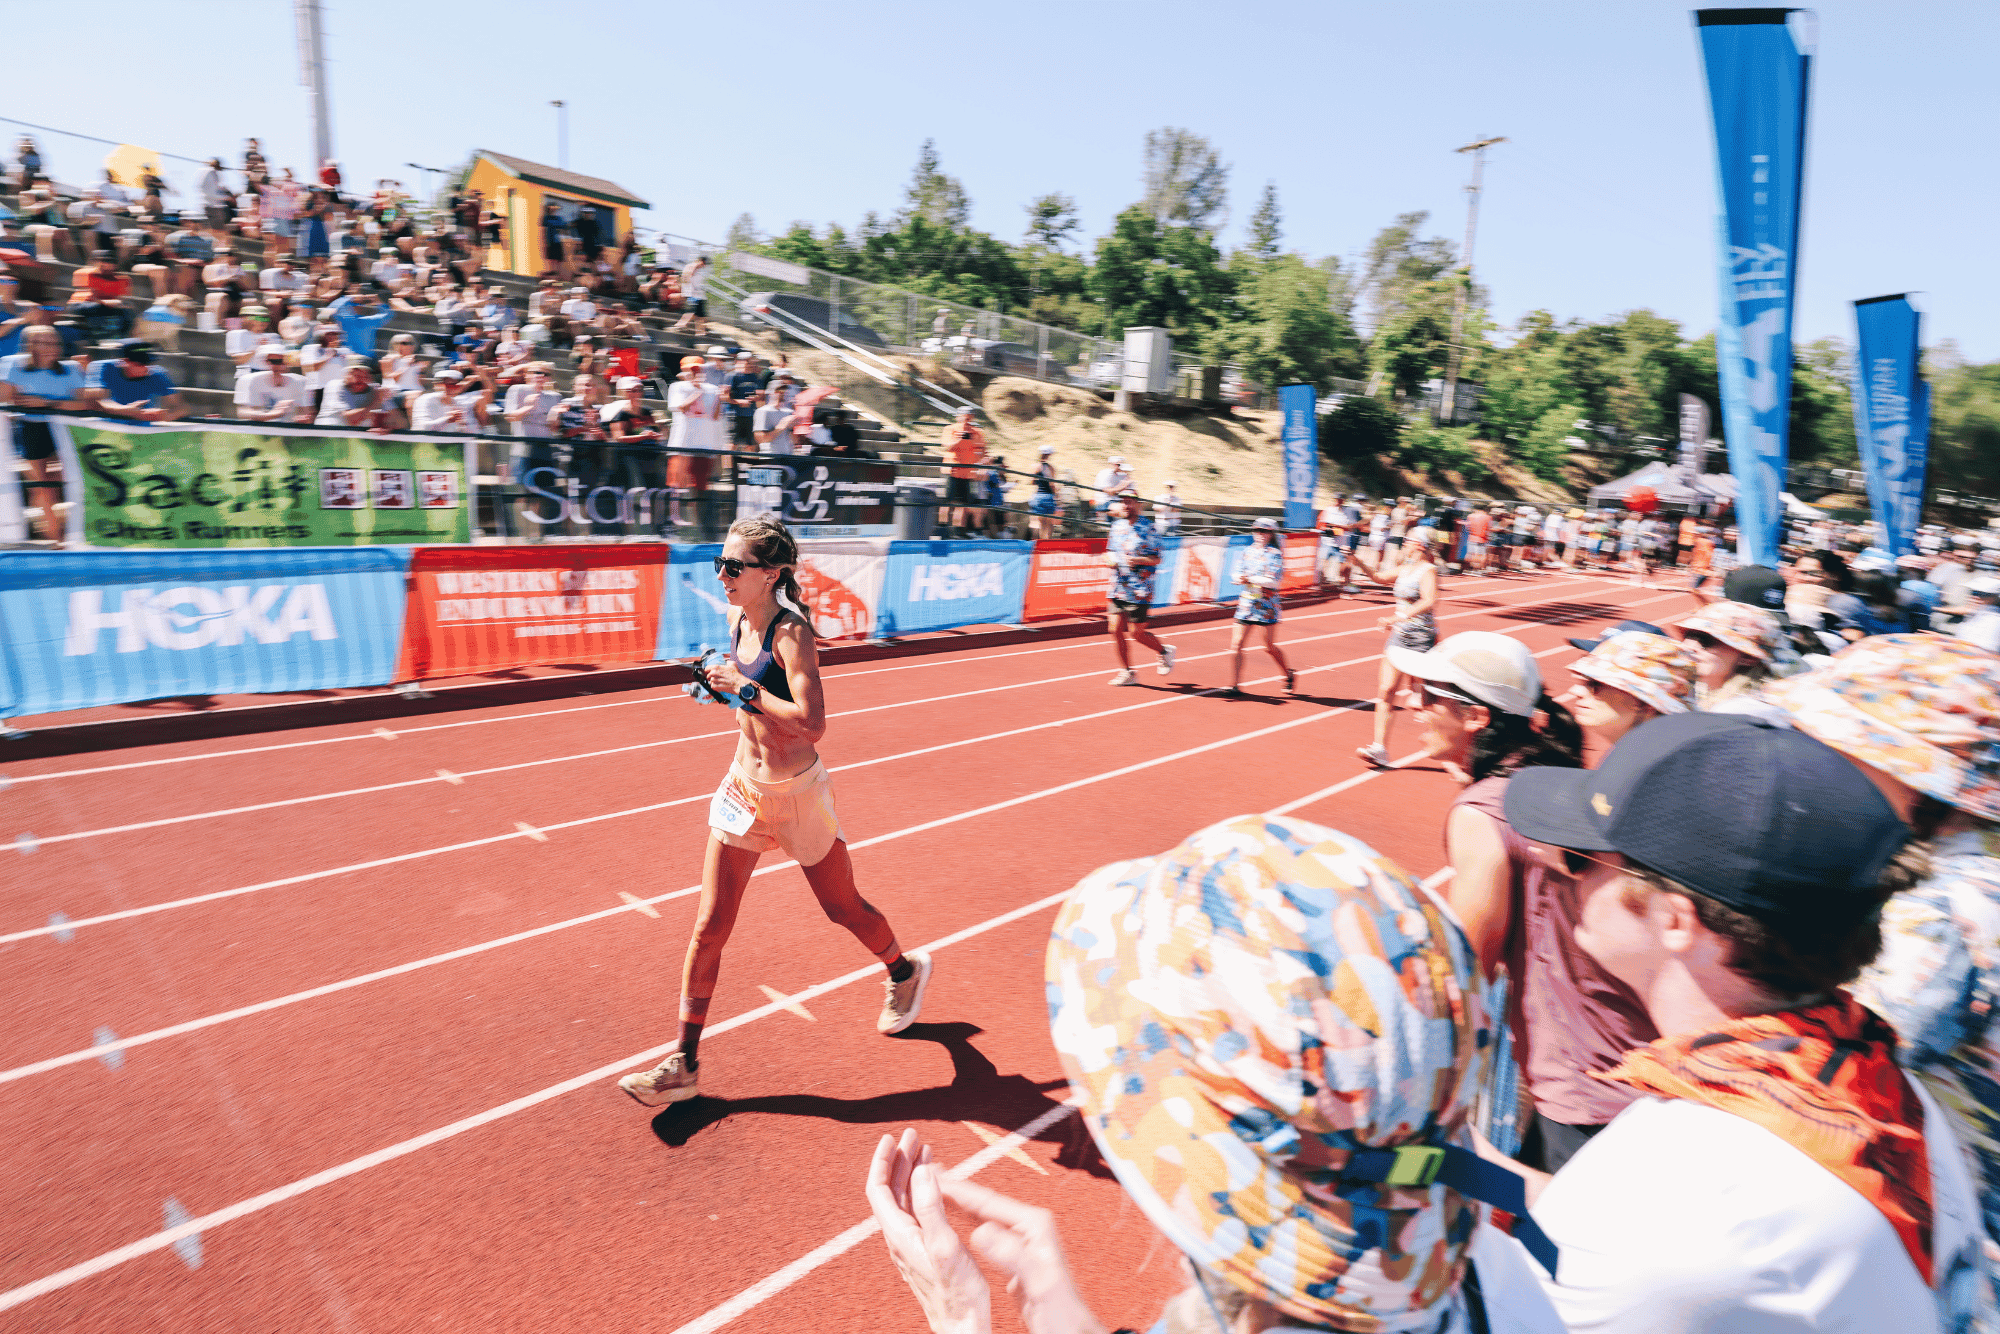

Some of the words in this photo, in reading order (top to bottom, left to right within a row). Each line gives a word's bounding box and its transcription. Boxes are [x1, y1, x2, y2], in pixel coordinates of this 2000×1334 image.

[1287, 439, 1313, 503] HOKA
[909, 563, 1004, 603] HOKA
[64, 583, 338, 656] HOKA
